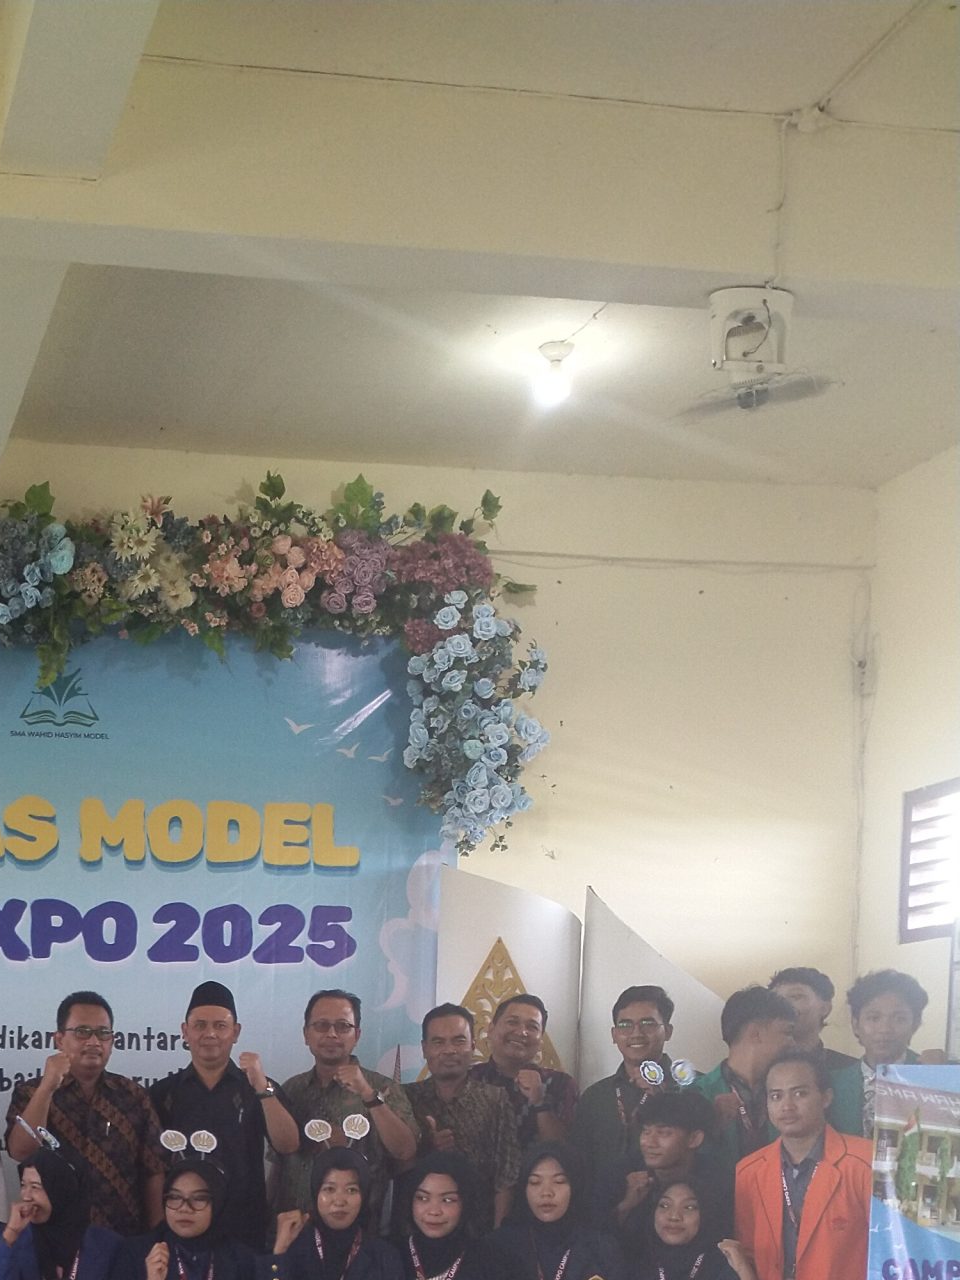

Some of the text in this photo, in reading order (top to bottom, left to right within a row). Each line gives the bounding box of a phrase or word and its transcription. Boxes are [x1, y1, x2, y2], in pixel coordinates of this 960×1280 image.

[84, 732, 110, 740] MODEL
[79, 798, 360, 868] MODEL
[147, 901, 357, 967] 2025
